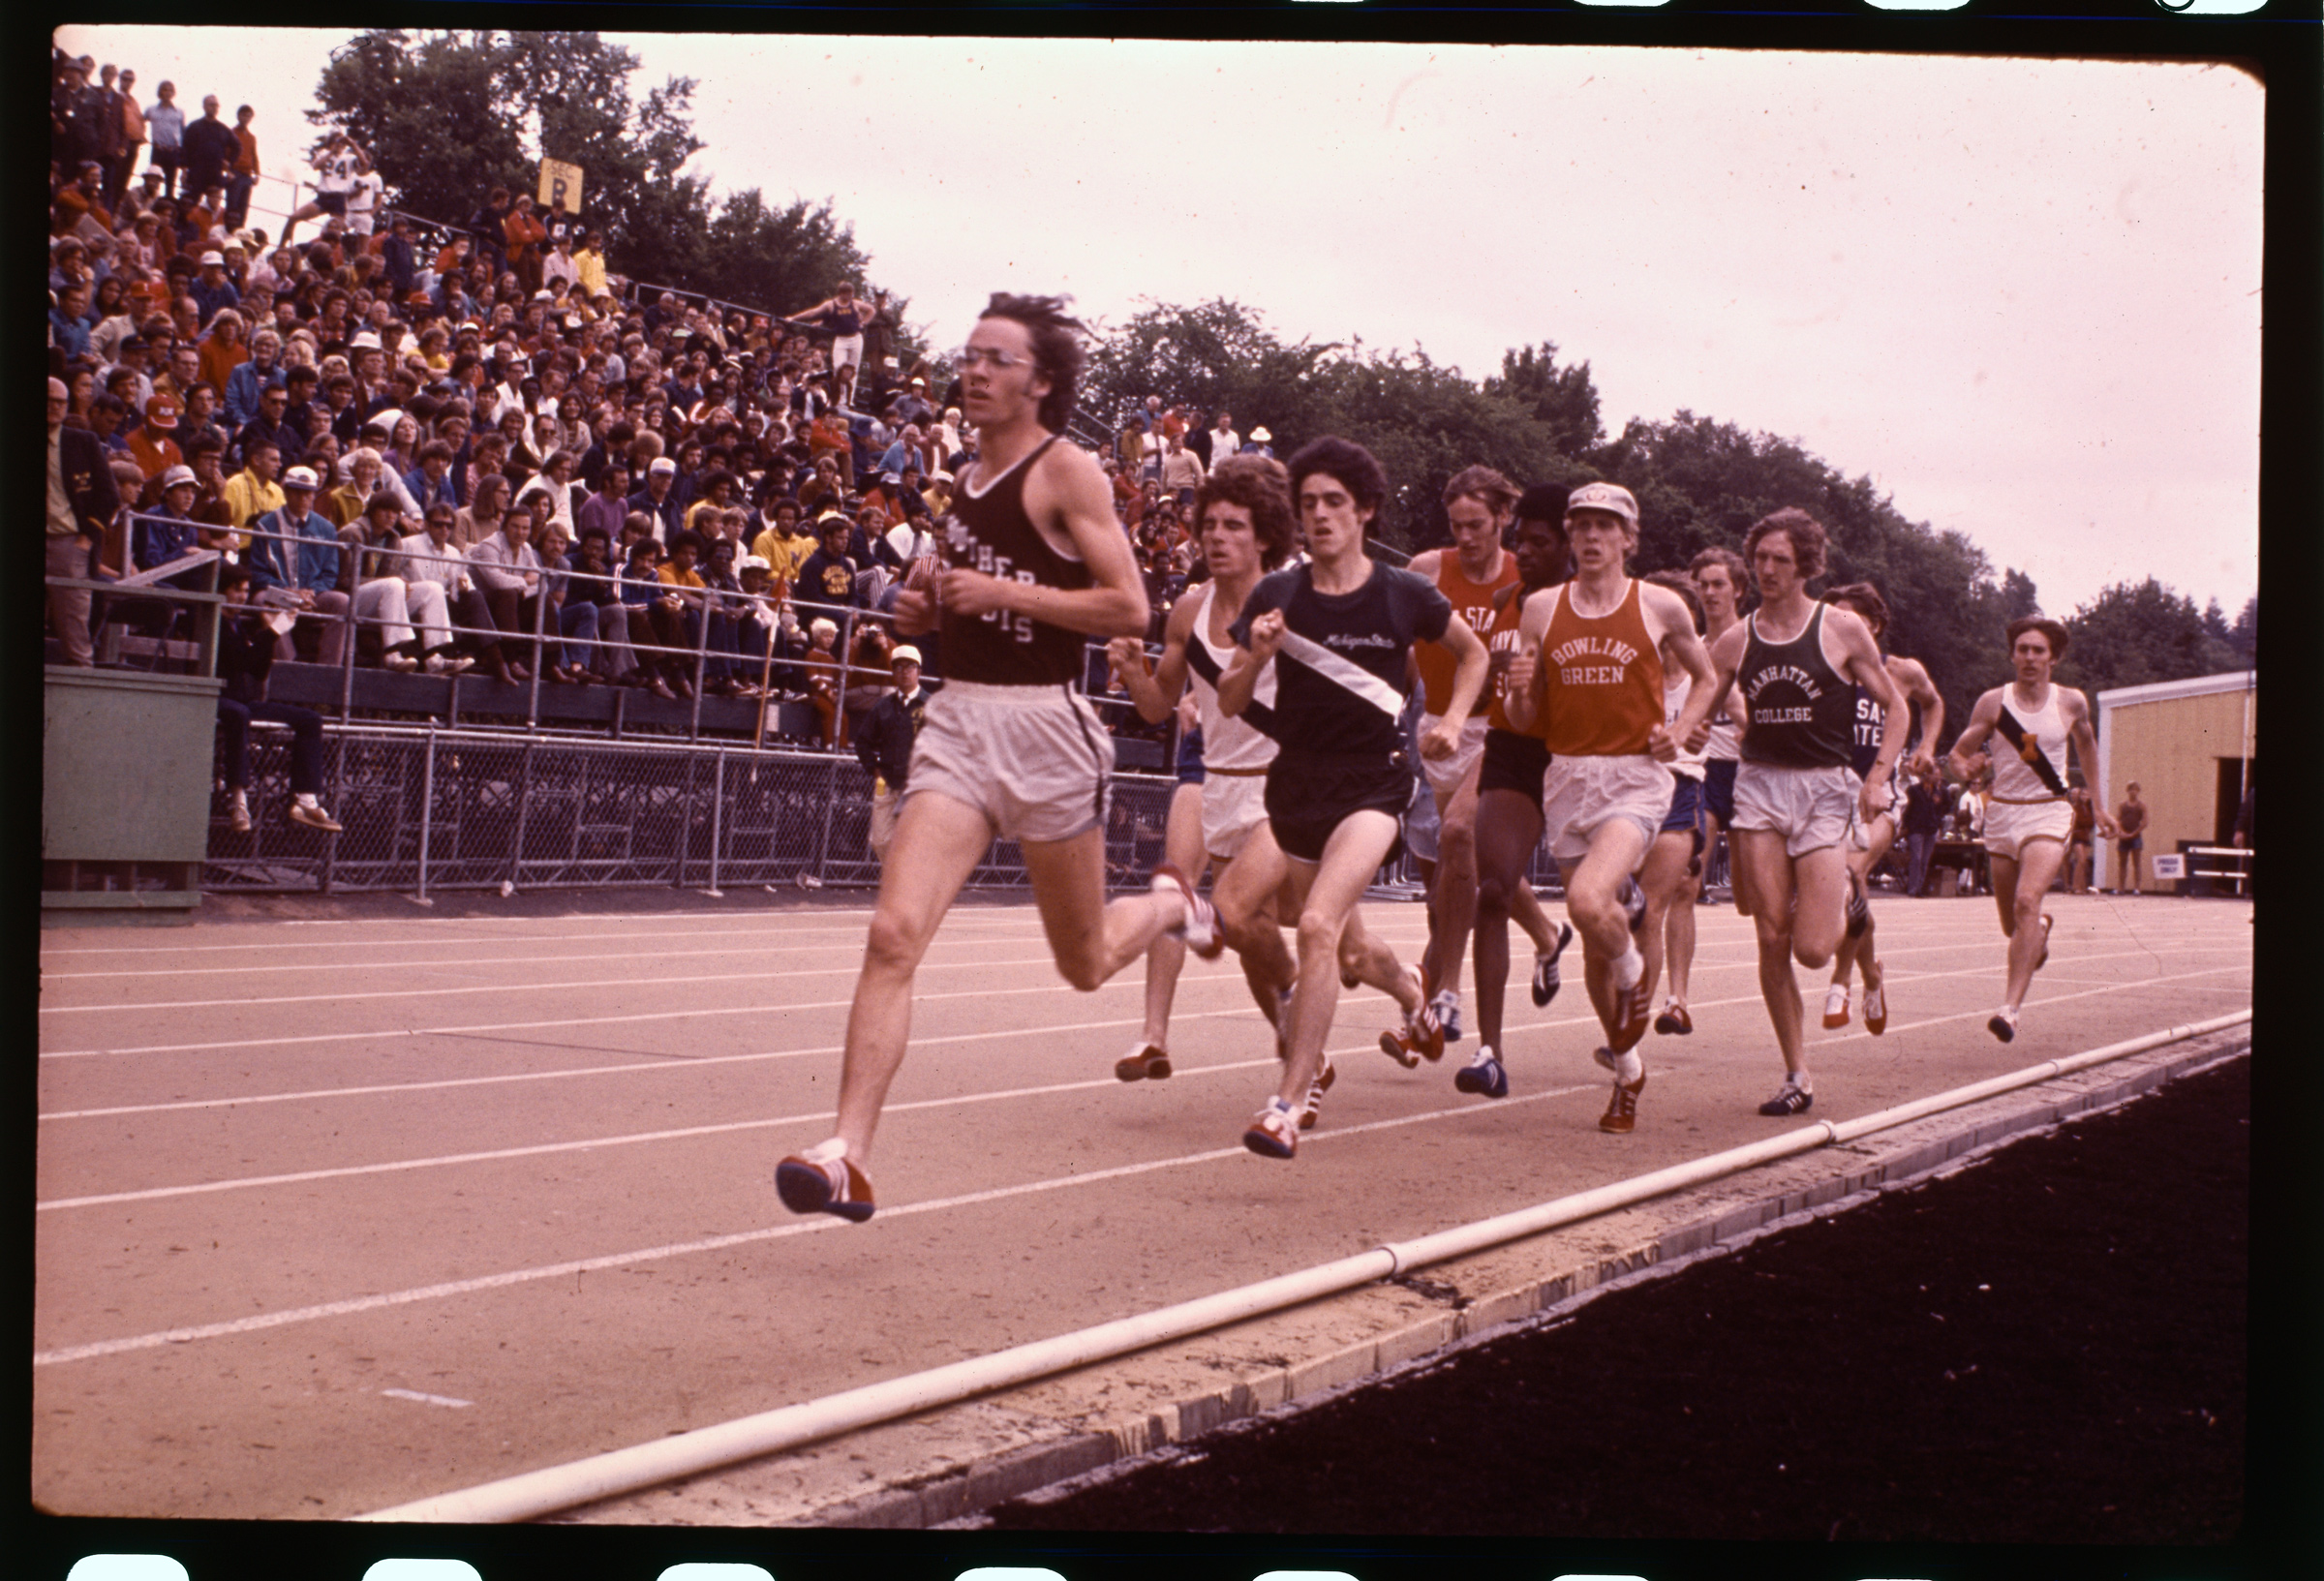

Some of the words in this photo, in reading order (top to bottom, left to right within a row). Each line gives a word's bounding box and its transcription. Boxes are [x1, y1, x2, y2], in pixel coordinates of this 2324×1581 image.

[1466, 607, 1496, 634] STA
[1550, 637, 1638, 666] BOWLING
[1560, 666, 1625, 685] GREEN
[1748, 665, 1822, 701] MANHATTAN
[1755, 707, 1813, 723] COLLEGE
